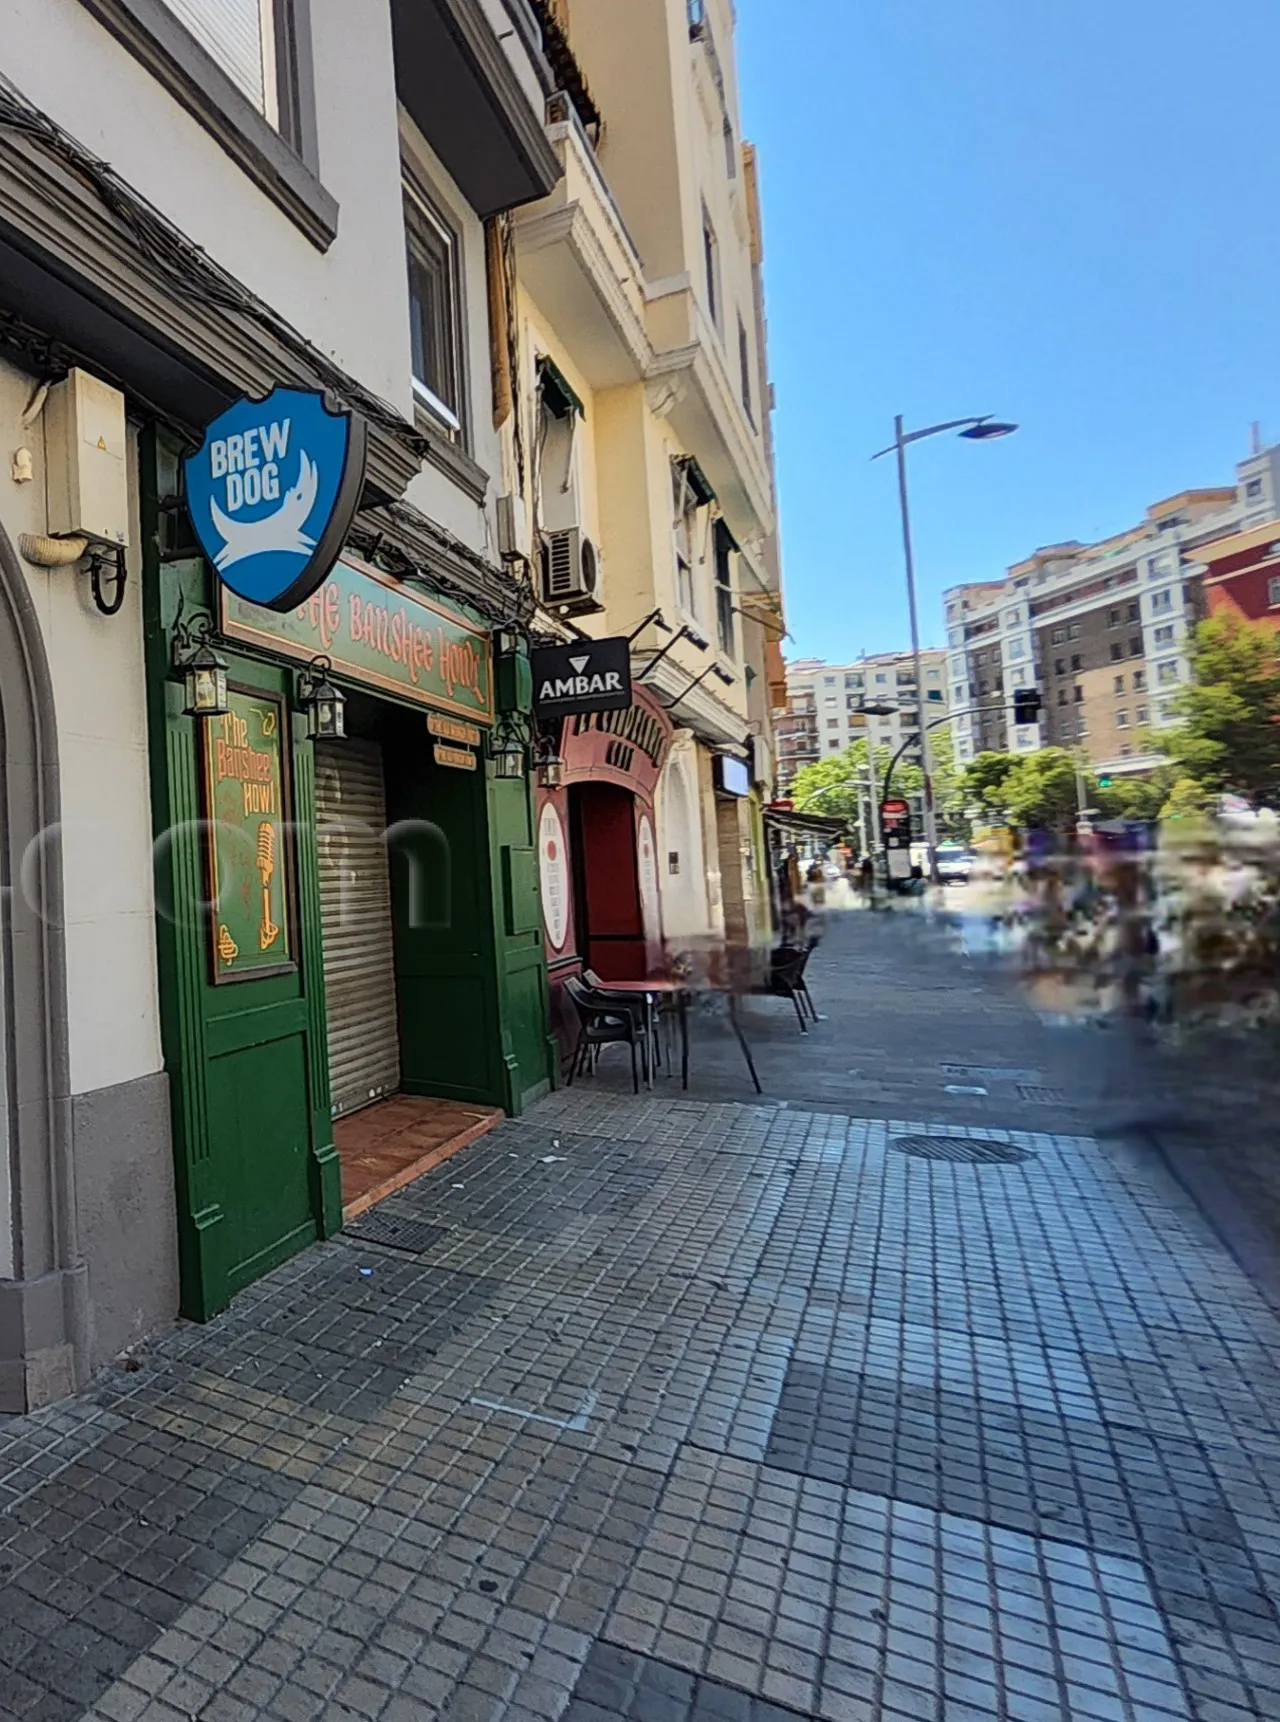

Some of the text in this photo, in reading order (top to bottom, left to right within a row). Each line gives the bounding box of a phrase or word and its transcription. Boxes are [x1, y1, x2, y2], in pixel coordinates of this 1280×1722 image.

[211, 418, 290, 479] BREW
[226, 463, 280, 512] DOG
[297, 582, 341, 649] HE
[539, 671, 624, 699] AMBAR
[220, 711, 249, 748] The
[216, 738, 273, 783] Banshee
